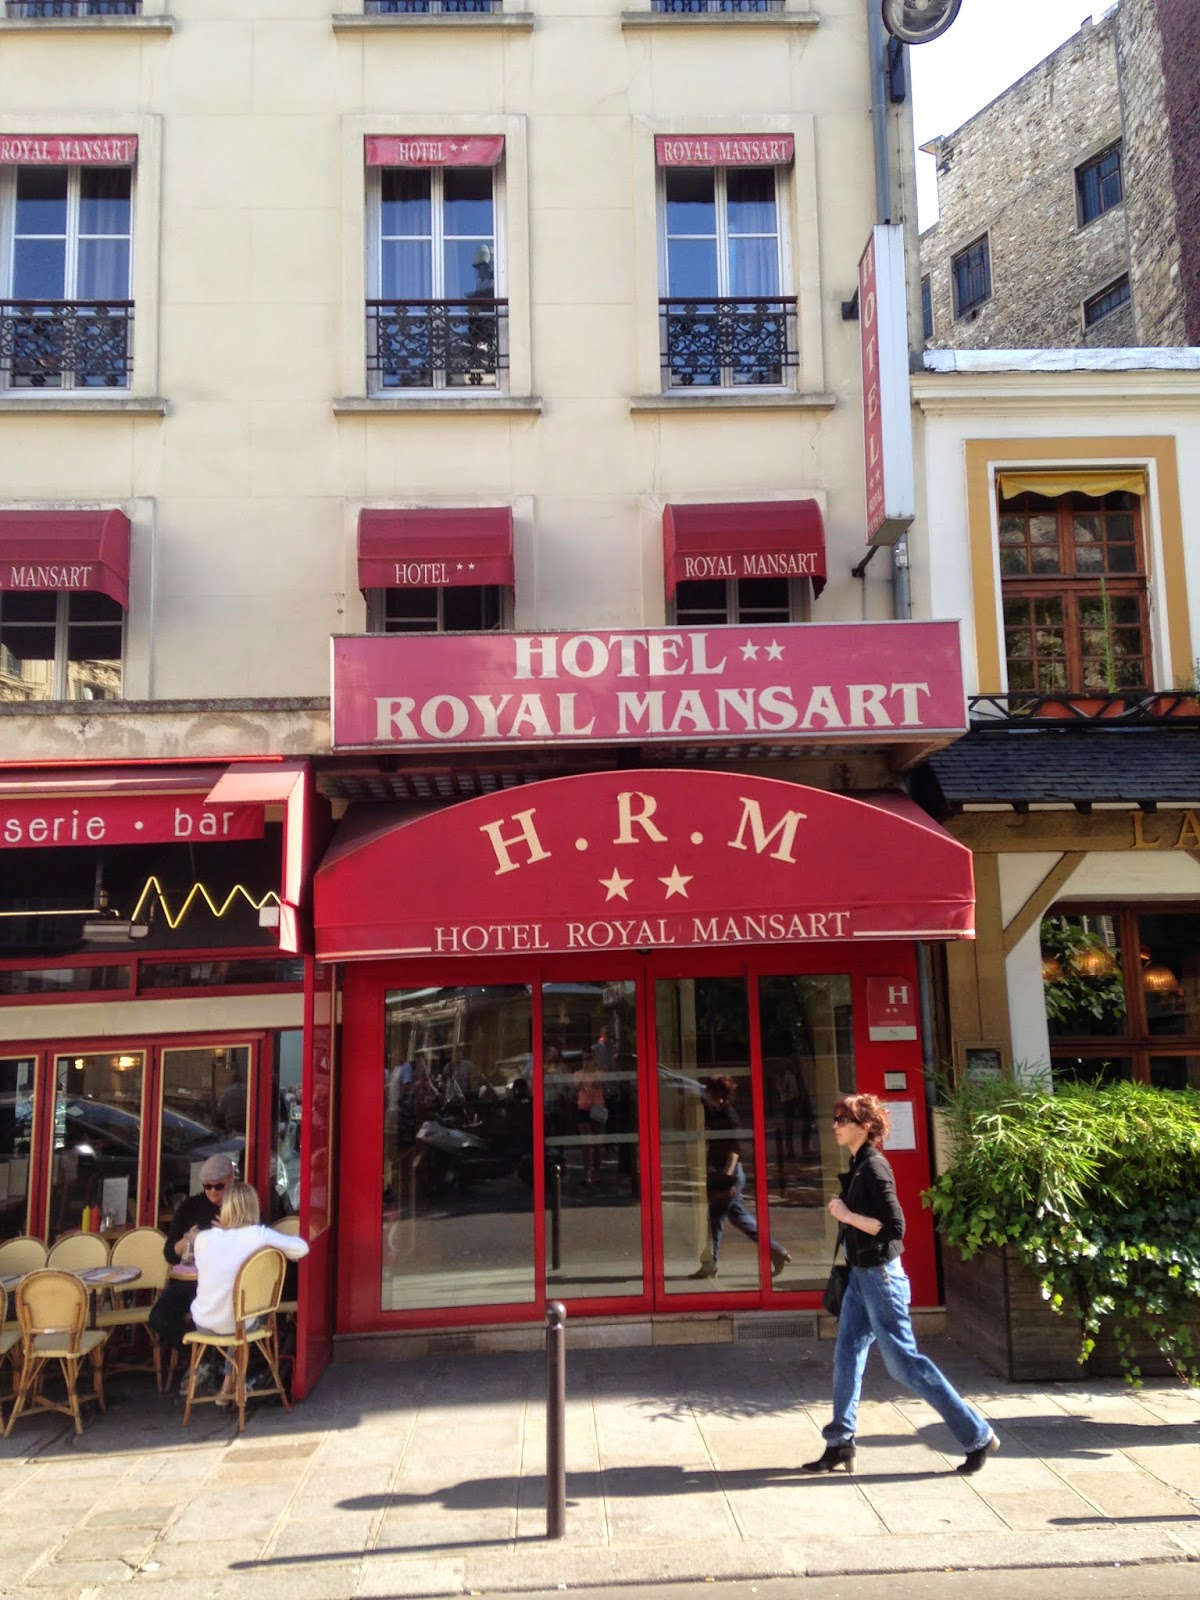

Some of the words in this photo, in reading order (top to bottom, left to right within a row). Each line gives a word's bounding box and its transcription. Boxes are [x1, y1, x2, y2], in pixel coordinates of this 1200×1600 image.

[1, 140, 51, 160] ROYAL
[58, 140, 132, 161] MANSART
[398, 142, 446, 161] HOTEL
[663, 141, 712, 161] ROYAL
[719, 140, 788, 160] MANSART
[862, 246, 880, 469] HOTEL
[394, 562, 450, 584] HOTEL
[684, 556, 736, 577] ROYAL
[743, 552, 818, 575] MANSART
[10, 566, 92, 588] MANSART
[512, 632, 728, 680] HOTEL
[373, 693, 596, 740] ROYAL
[616, 682, 931, 734] MANSART
[174, 807, 234, 837] bar
[434, 924, 550, 952] HOTEL
[566, 919, 676, 948] ROYAL
[691, 911, 850, 942] MANSART
[888, 986, 909, 1005] H
